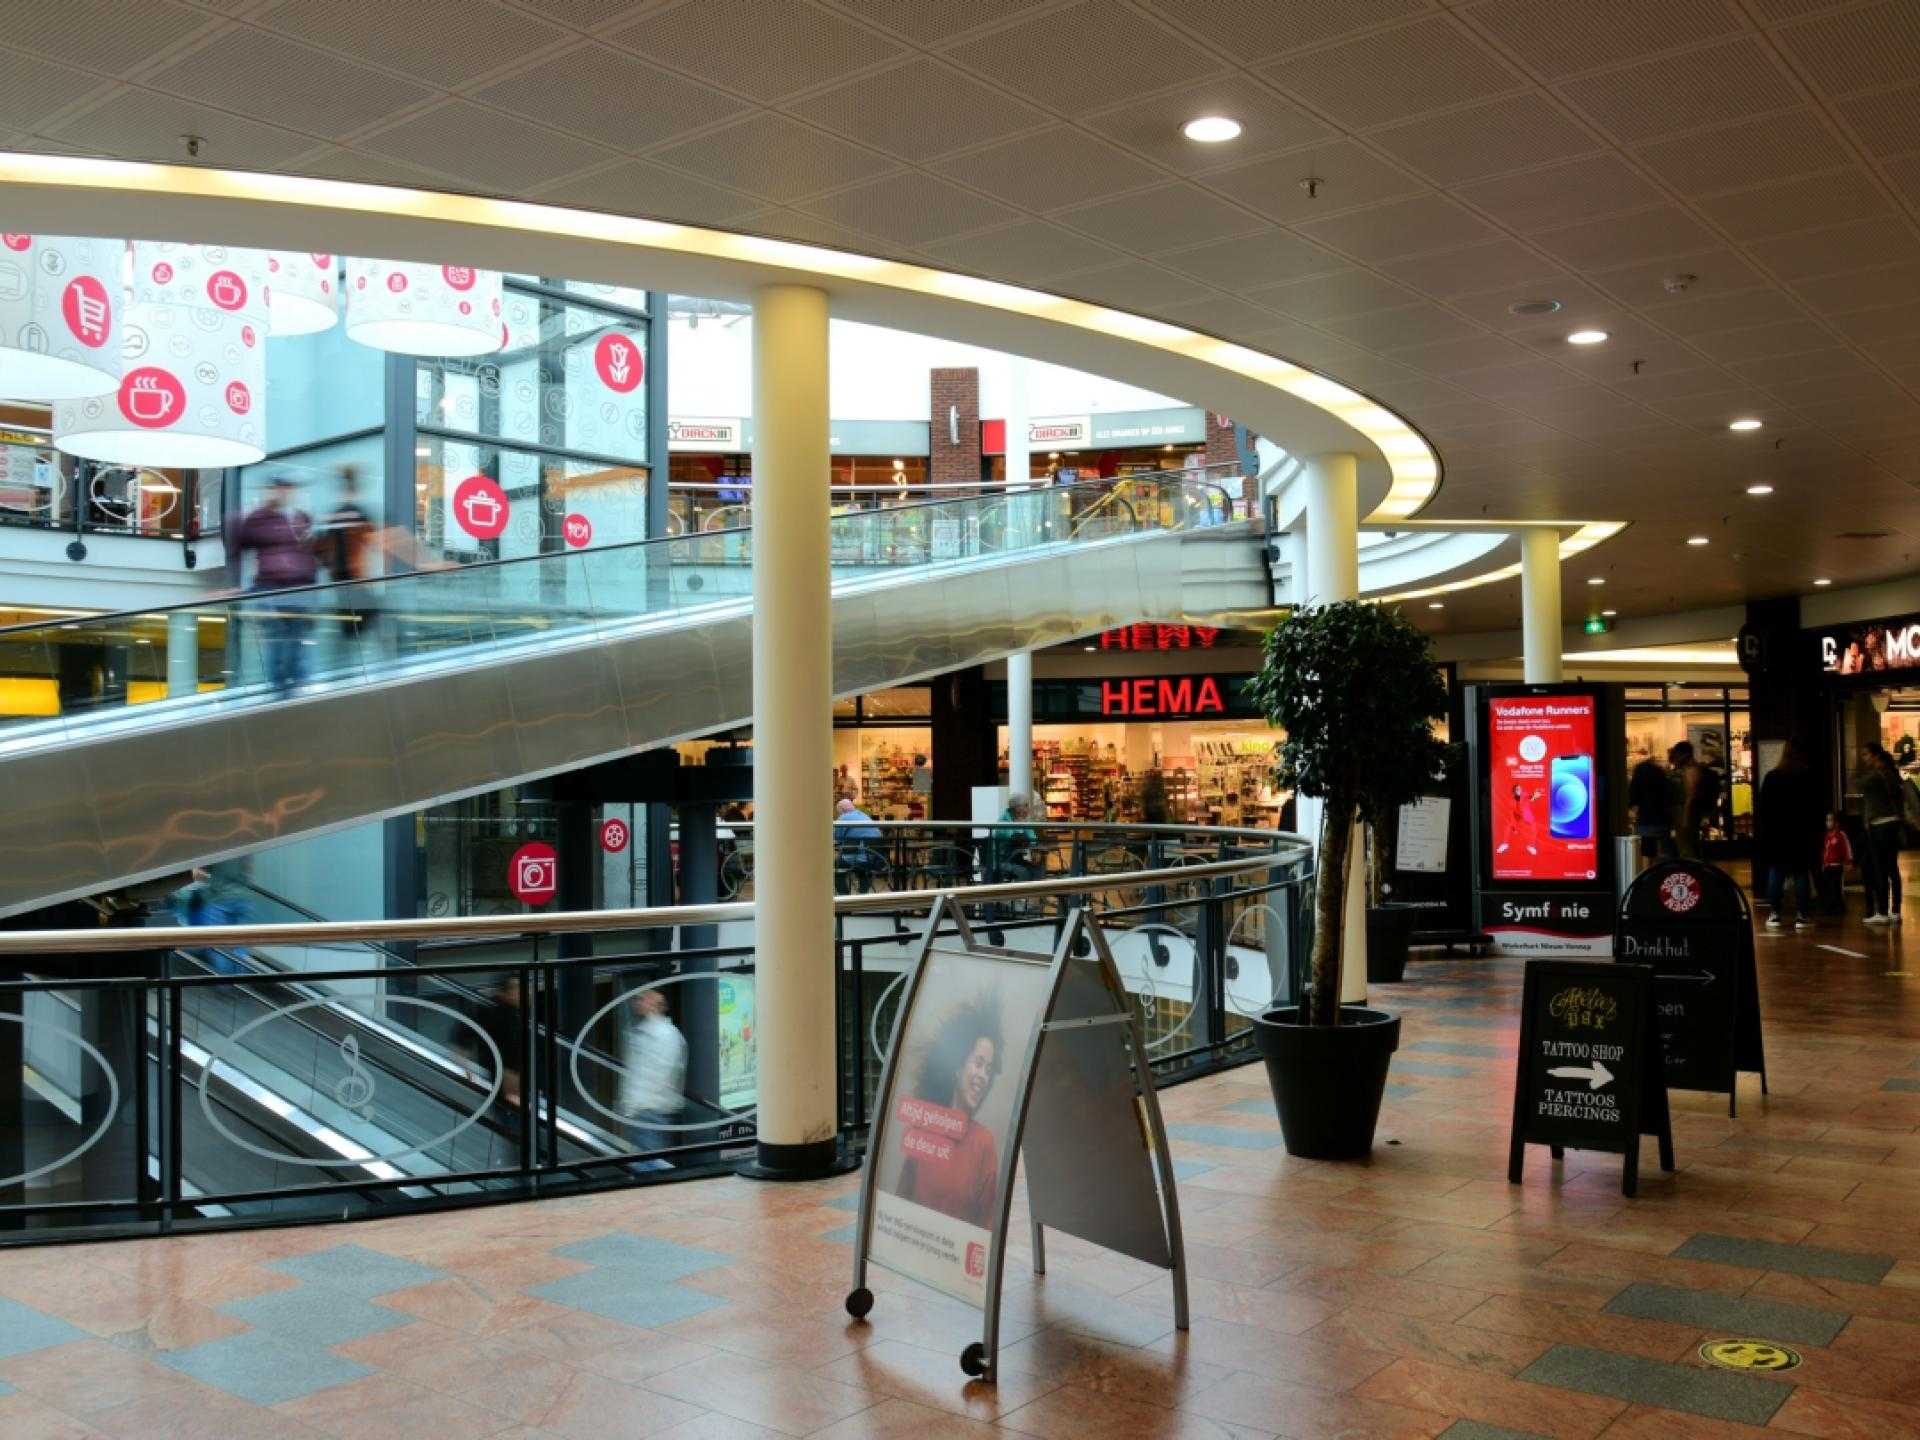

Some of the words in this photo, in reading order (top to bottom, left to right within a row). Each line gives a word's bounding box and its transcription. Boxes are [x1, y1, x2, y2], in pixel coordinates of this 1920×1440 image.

[1101, 676, 1225, 715] HEMA
[1495, 706, 1544, 717] Vodafone
[1546, 705, 1590, 716] Runners
[1542, 1040, 1590, 1059] TATTOO
[1591, 1044, 1624, 1061] SHOP
[1544, 1089, 1616, 1108] TATTOOS
[1538, 1102, 1621, 1122] PIERCINGS
